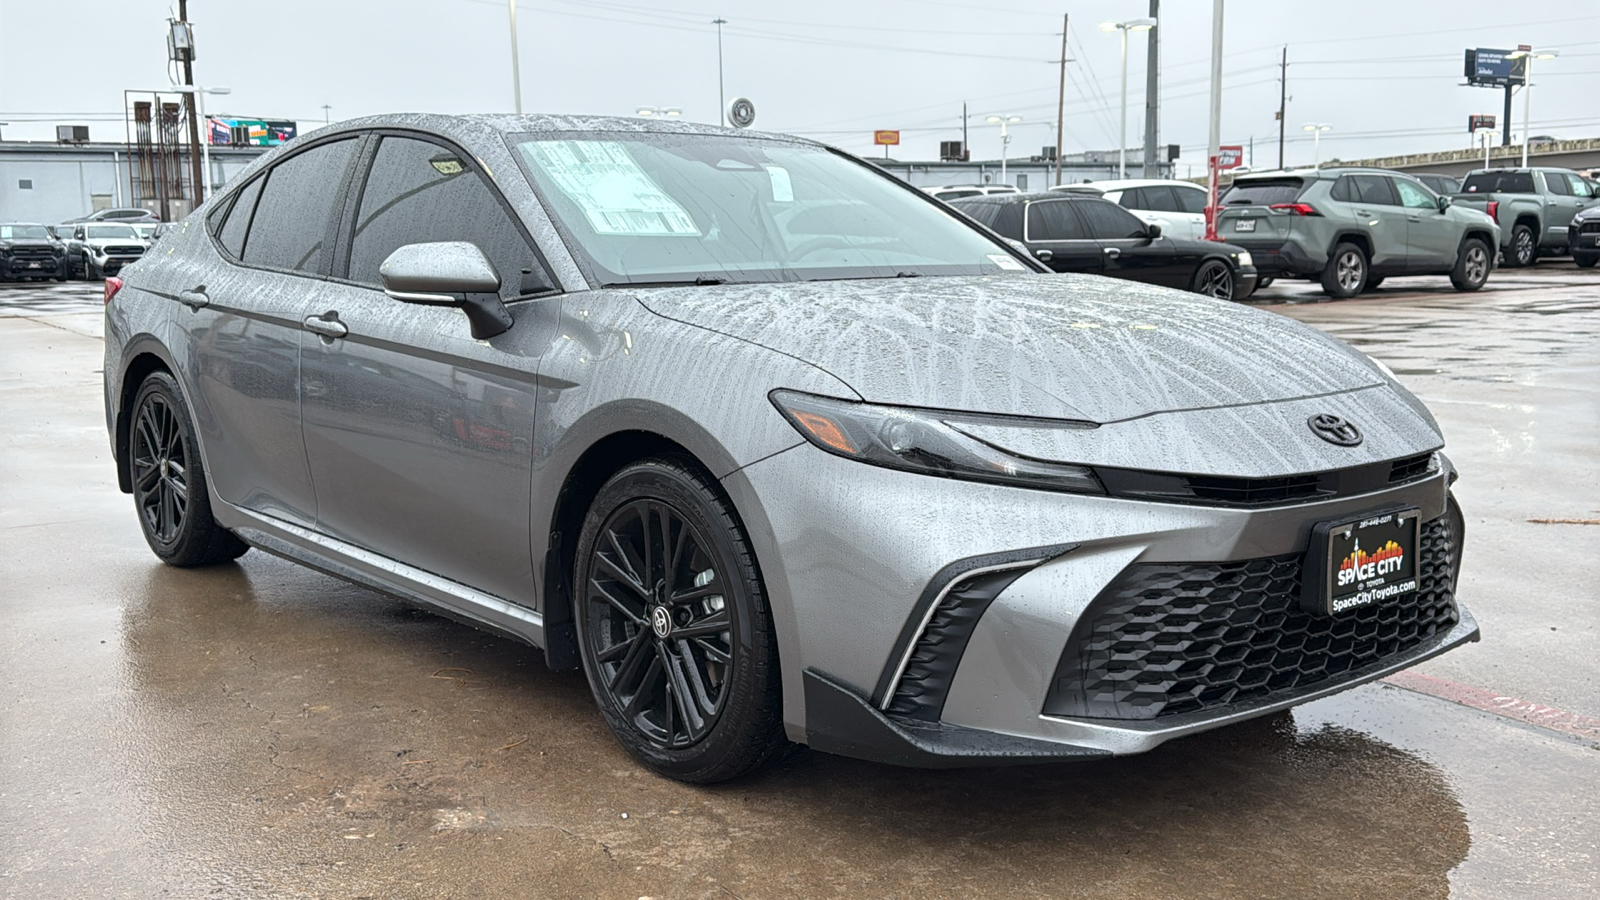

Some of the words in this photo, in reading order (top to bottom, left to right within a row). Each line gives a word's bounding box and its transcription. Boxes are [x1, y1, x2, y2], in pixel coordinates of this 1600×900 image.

[1338, 556, 1376, 586] SPACE
[1377, 555, 1404, 575] CITY
[1366, 578, 1385, 588] TOYOTA
[1332, 580, 1416, 612] SpaceCityToyota.com
